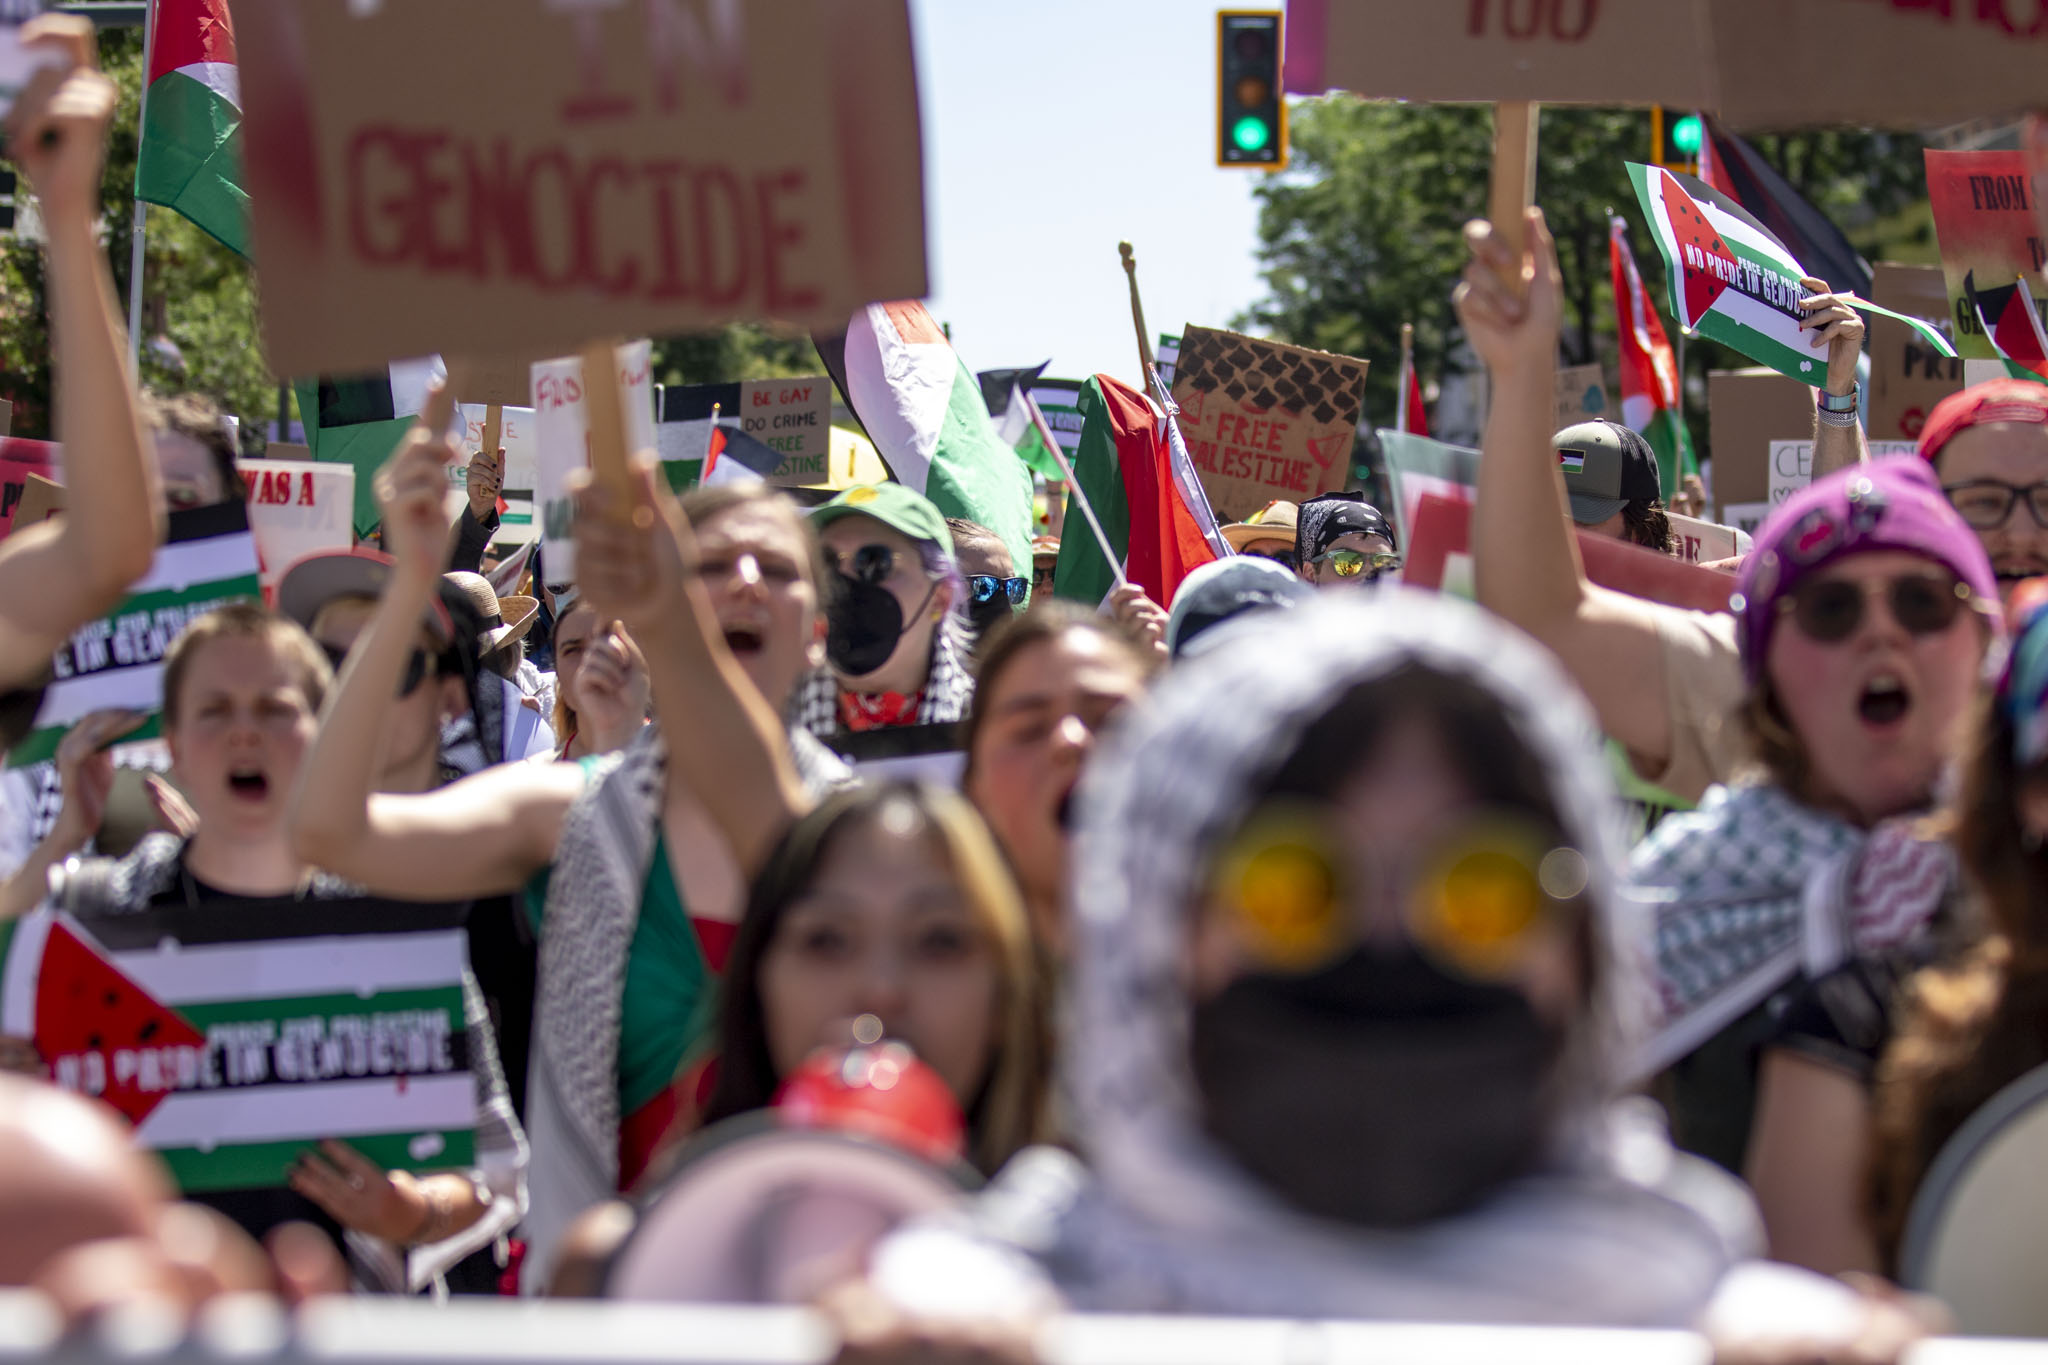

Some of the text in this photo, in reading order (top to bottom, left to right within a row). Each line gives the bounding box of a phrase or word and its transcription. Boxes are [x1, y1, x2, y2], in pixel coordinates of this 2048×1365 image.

[553, 0, 752, 126] IN
[1969, 175, 2028, 210] FROM
[343, 120, 824, 314] GENOCIDE
[1685, 243, 1704, 270] NO
[1763, 276, 1815, 318] GENOC
[1763, 268, 1779, 286] FOR
[752, 387, 812, 407] BE GAY
[744, 411, 818, 432] DO CRIME
[1217, 411, 1289, 452] FREE
[772, 453, 826, 476] STINE
[297, 471, 315, 506] A
